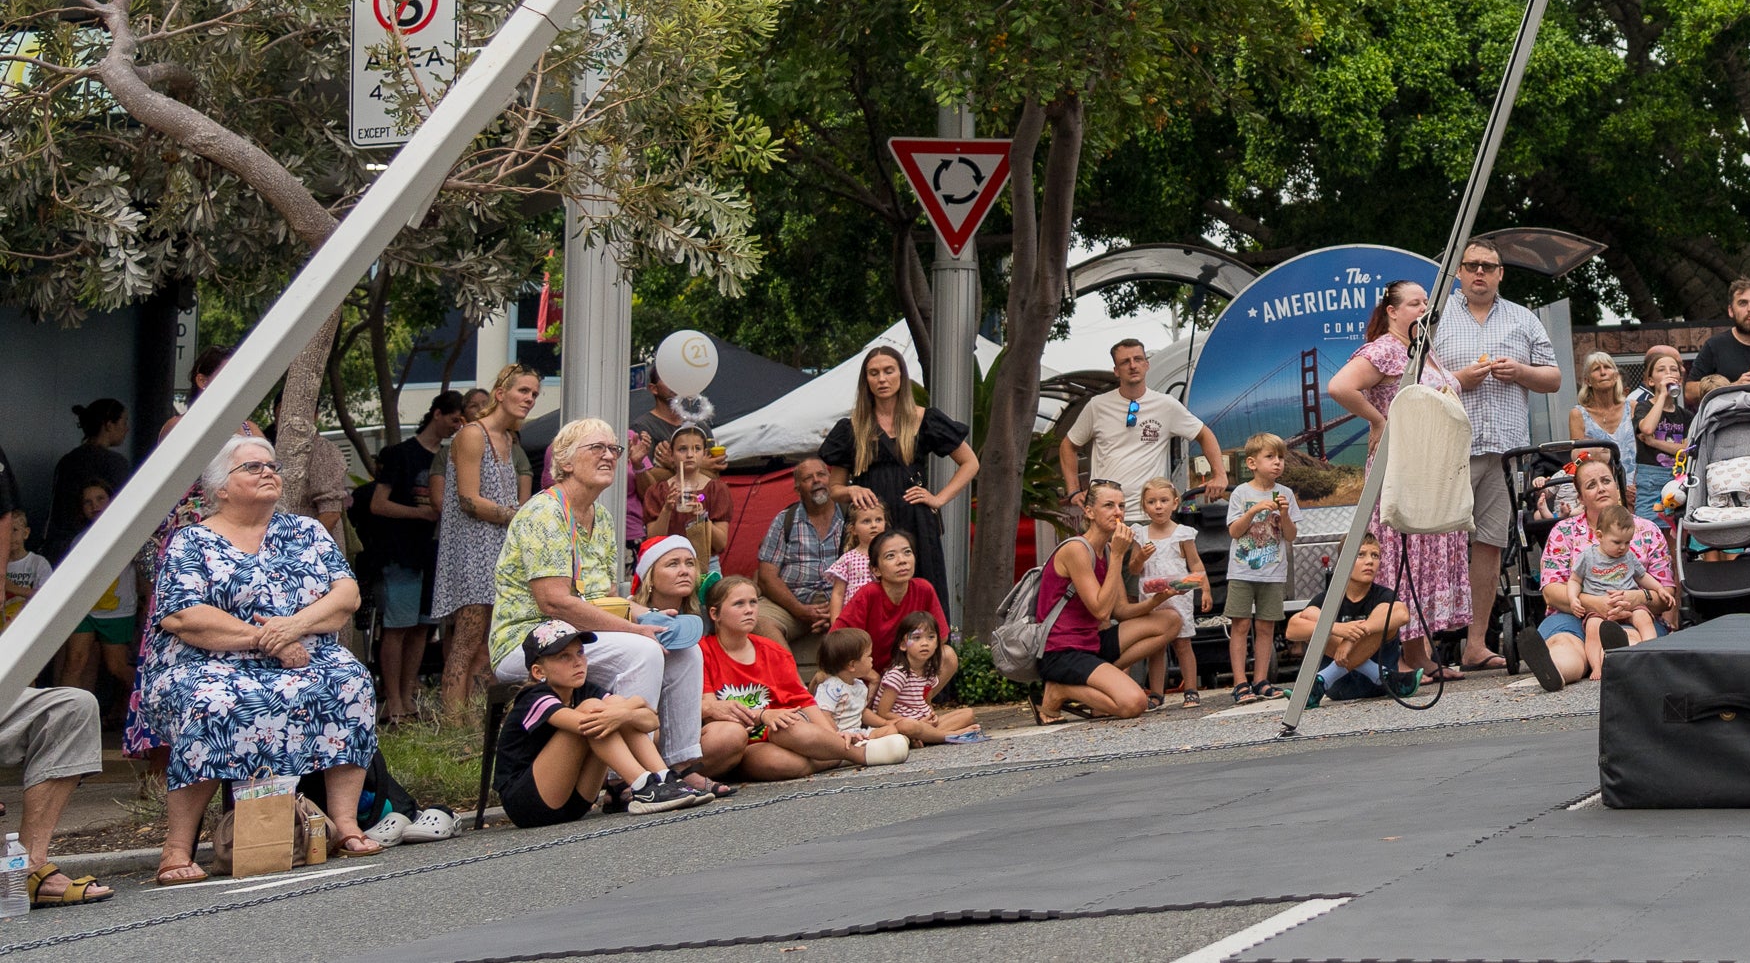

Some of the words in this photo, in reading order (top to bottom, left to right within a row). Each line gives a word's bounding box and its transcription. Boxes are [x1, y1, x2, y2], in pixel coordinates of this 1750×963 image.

[357, 126, 391, 140] EXCEPT
[1346, 267, 1372, 285] The
[1263, 287, 1366, 323] AMERICAN
